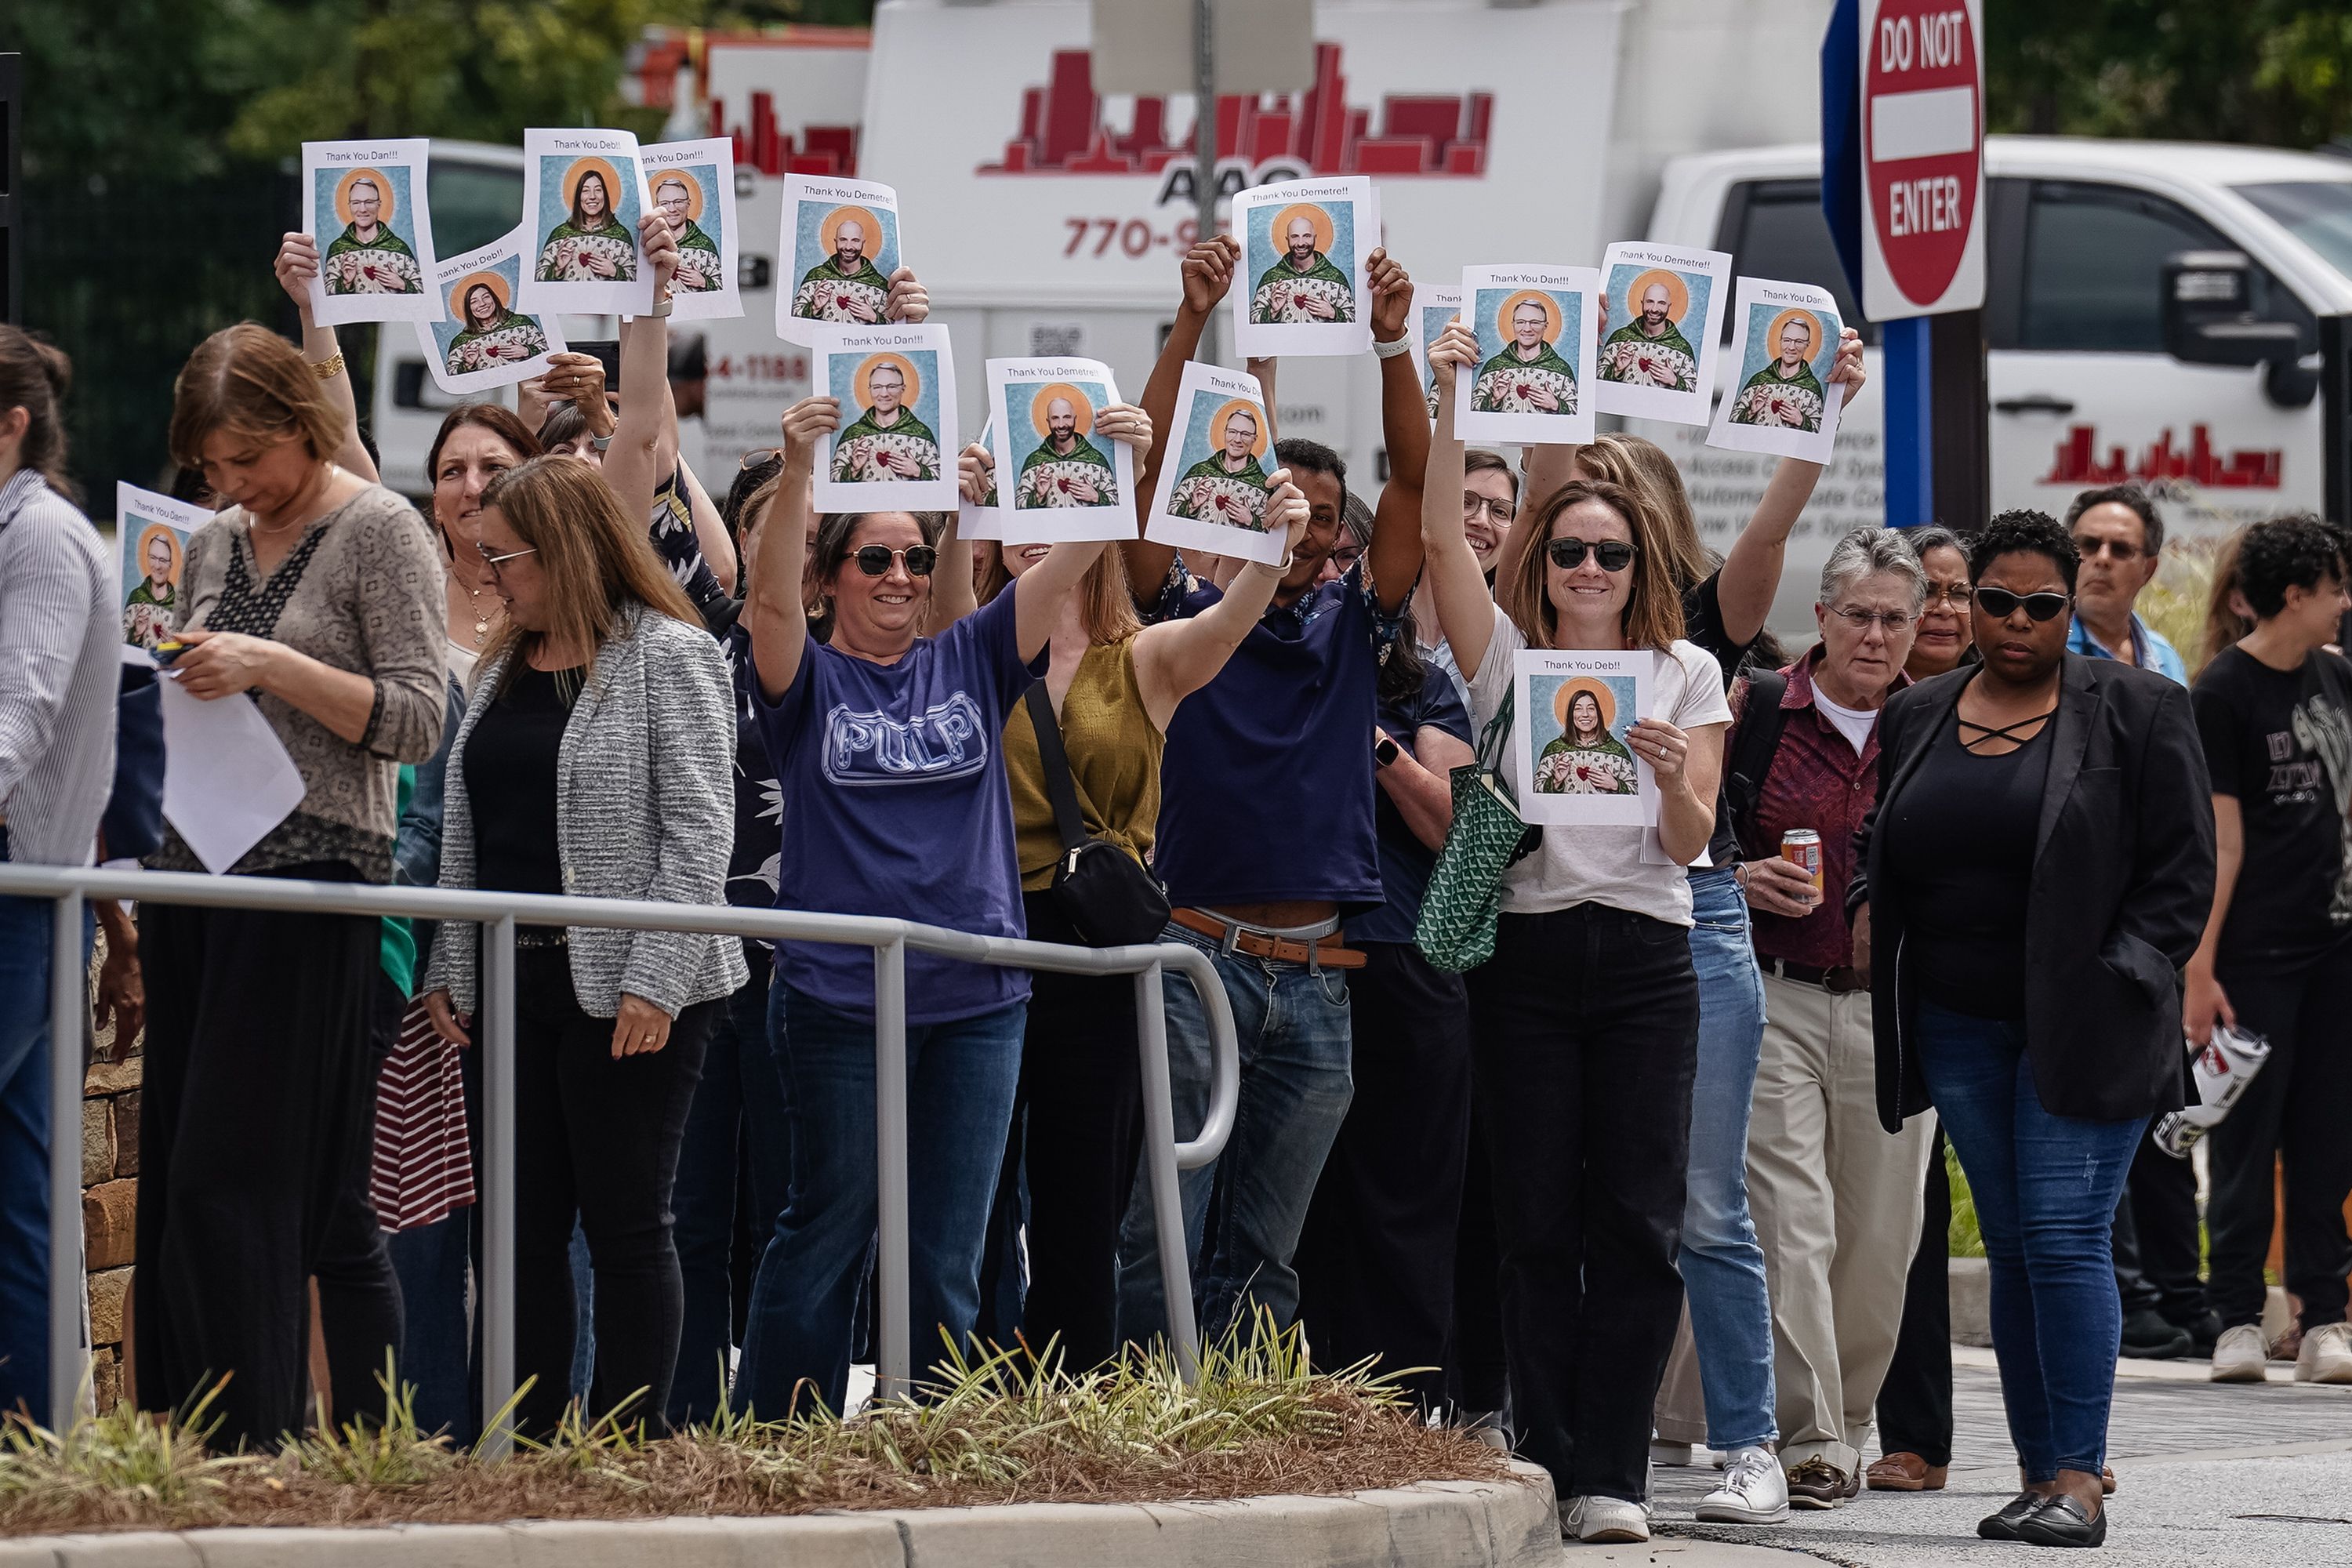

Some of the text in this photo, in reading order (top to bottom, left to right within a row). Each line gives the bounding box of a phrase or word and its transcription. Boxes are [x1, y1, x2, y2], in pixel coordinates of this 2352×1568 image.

[1881, 10, 1964, 73] DO NOT
[554, 140, 622, 150] Thank You Deb!!
[326, 151, 398, 162] Thank You Dan!!!
[657, 154, 673, 163] You
[676, 151, 704, 161] Dan!!!
[804, 186, 833, 196] Thank
[835, 188, 852, 198] You
[1251, 192, 1279, 201] Thank
[1301, 187, 1348, 197] Demetre!!
[1890, 176, 1962, 238] ENTER
[460, 261, 477, 270] You
[479, 249, 503, 264] Deb!!
[1620, 251, 1711, 270] Thank You Demetre!!
[1490, 274, 1569, 285] Thank You Dan!!!
[1762, 289, 1788, 300] Thank
[1790, 292, 1804, 302] You
[842, 336, 924, 346] Thank You Dan!!!
[1007, 368, 1036, 377] Thank
[1036, 368, 1054, 376] You
[1210, 377, 1236, 390] Thank
[1238, 383, 1251, 394] You
[134, 499, 154, 514] Thank
[156, 506, 169, 517] You
[1544, 660, 1621, 670] Thank You Deb!!
[831, 704, 975, 775] PULP
